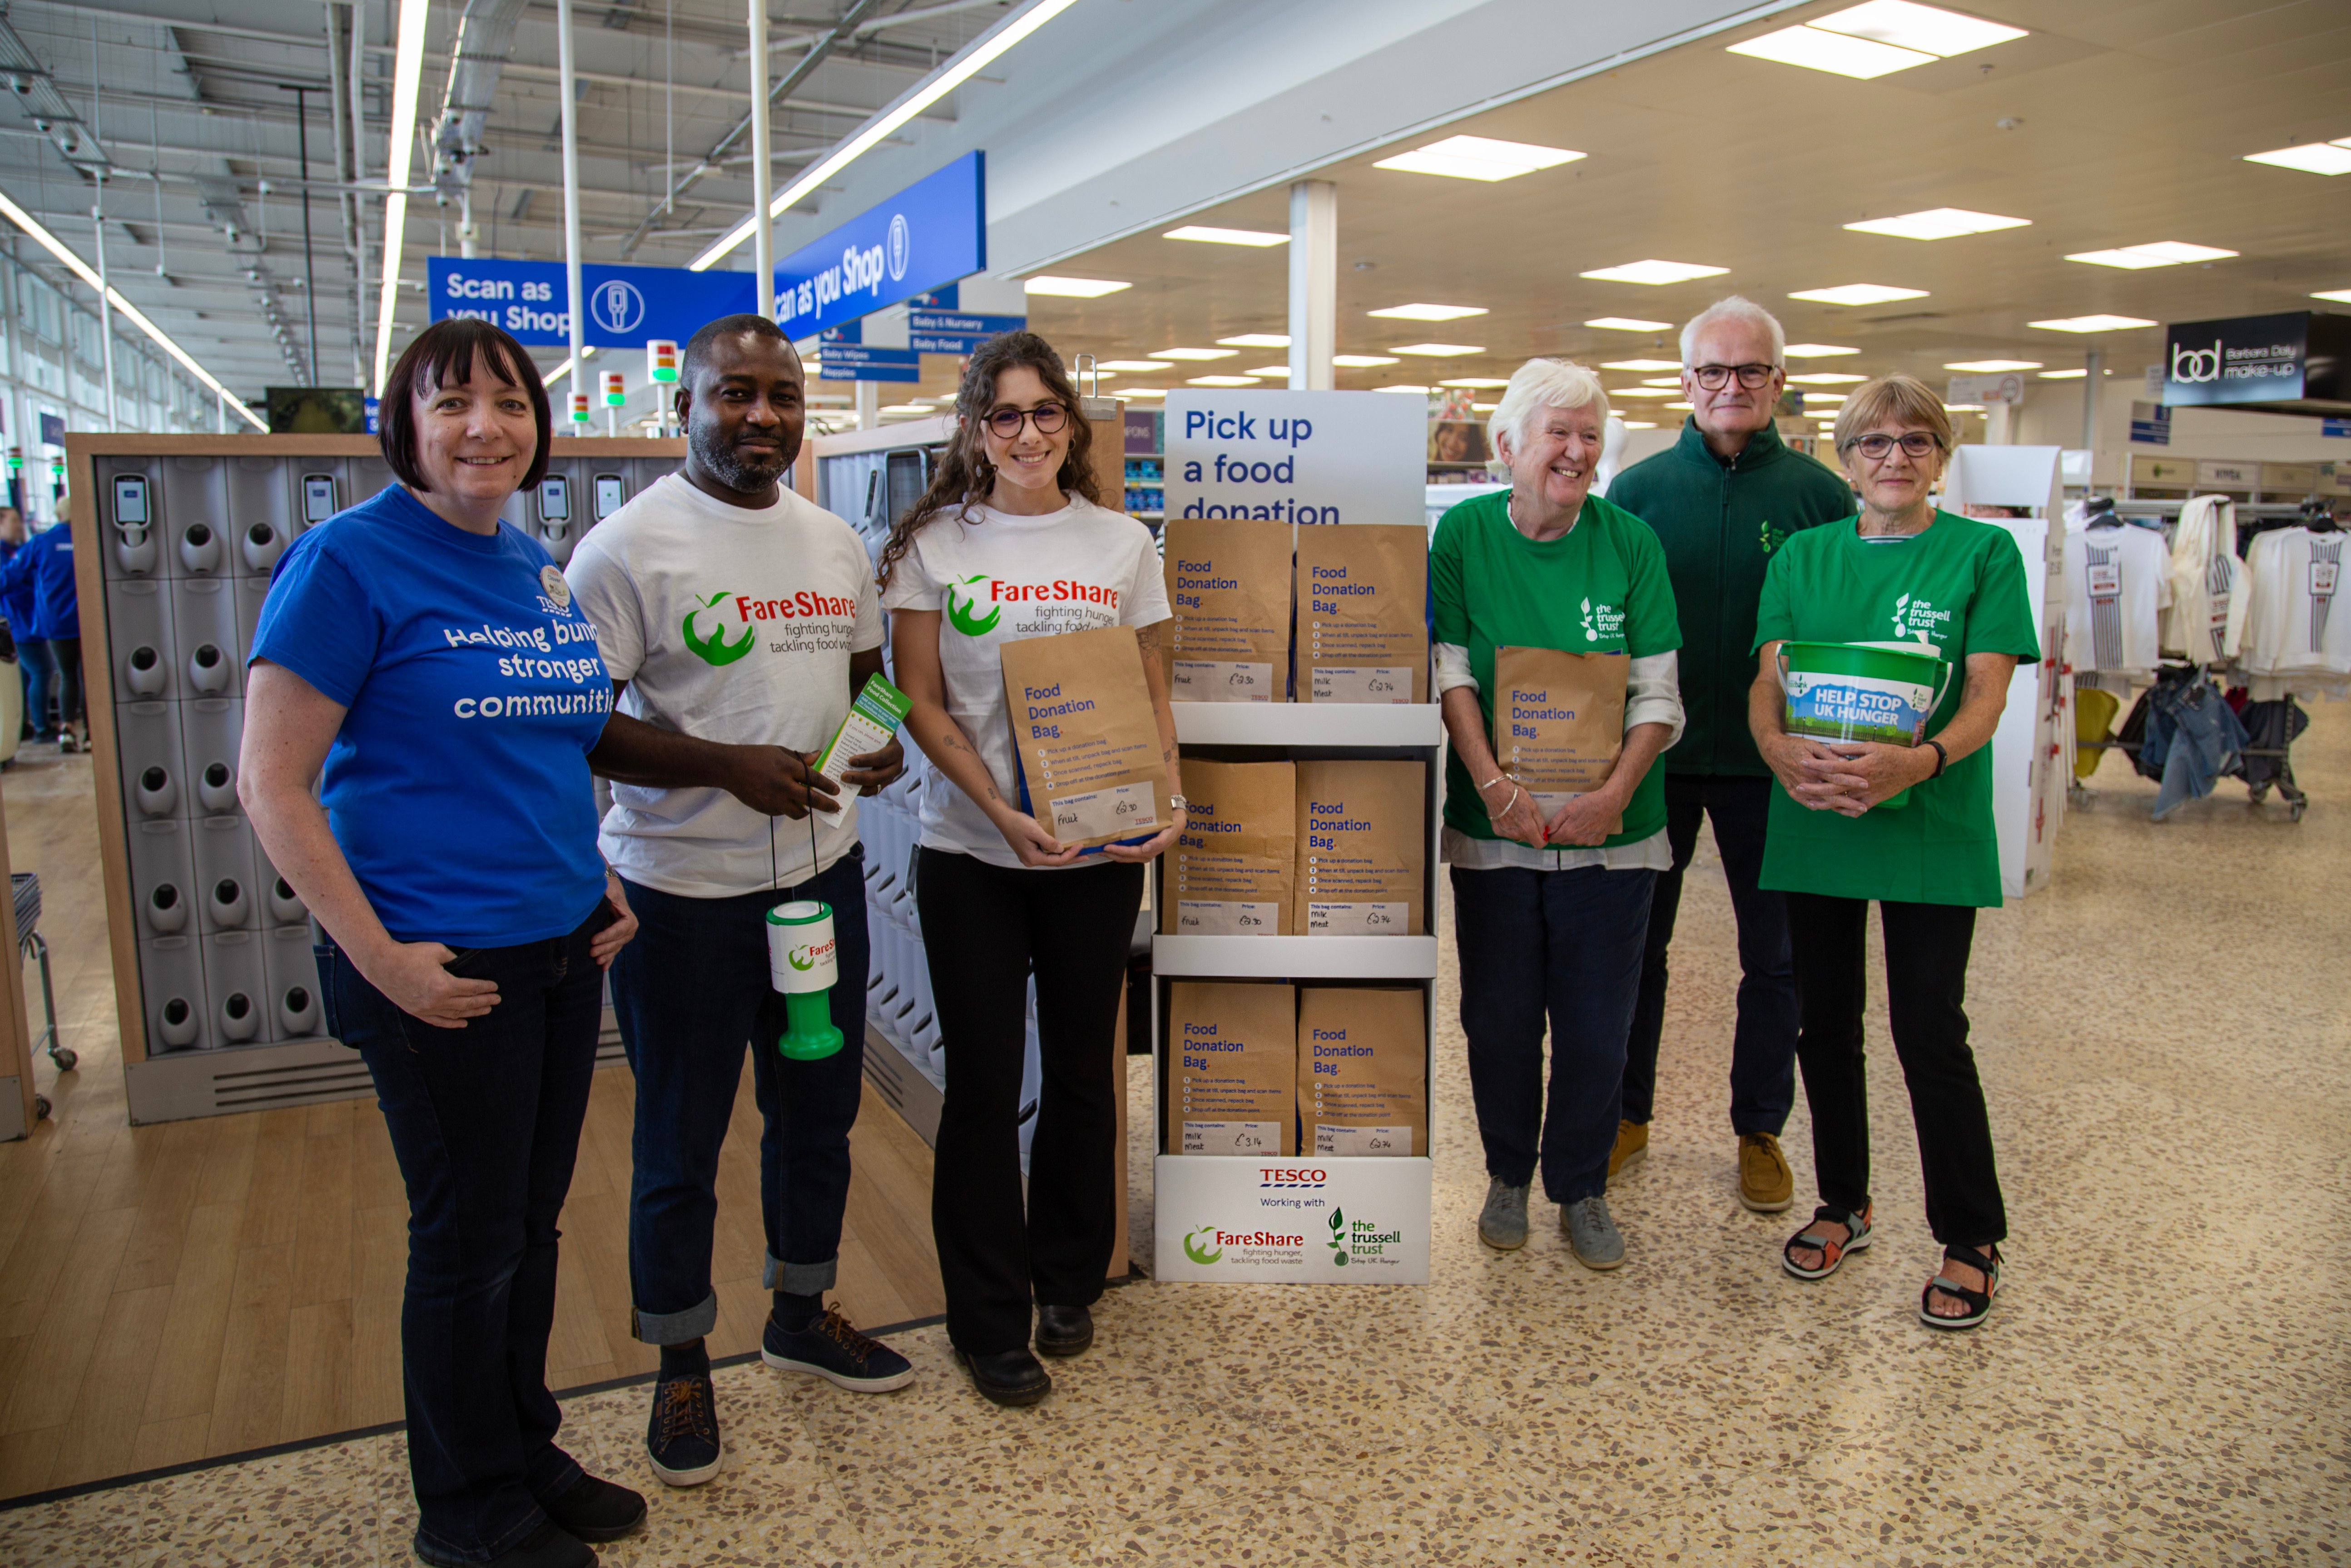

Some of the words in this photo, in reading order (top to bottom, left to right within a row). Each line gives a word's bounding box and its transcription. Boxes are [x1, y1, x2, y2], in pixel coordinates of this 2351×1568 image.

[446, 272, 515, 300] Scan
[521, 281, 552, 302] as
[774, 287, 796, 326] can
[797, 279, 813, 316] as
[813, 265, 840, 320] you
[843, 244, 884, 297] Shop
[506, 305, 570, 337] Shop
[913, 316, 937, 328] Baby
[945, 317, 982, 330] Nursery
[913, 338, 937, 350] Baby
[938, 339, 962, 350] Food
[822, 349, 842, 360] Baby
[843, 350, 869, 361] Wipes
[2271, 345, 2296, 358] Daly
[823, 367, 856, 378] Nappies
[2224, 363, 2295, 379] make-up
[1186, 410, 1256, 440] Pick
[1270, 418, 1312, 448] up
[1184, 460, 1202, 482] a
[1215, 454, 1294, 483] food
[1183, 497, 1339, 524] donation
[1177, 560, 1211, 572] Food
[1312, 566, 1347, 578] Food
[1177, 577, 1237, 589] Donation
[1312, 583, 1375, 595] Donation
[991, 580, 1118, 609] FareShare
[1176, 594, 1203, 608] Bag.
[735, 591, 855, 623] FareShare
[1312, 600, 1340, 615] Bag.
[1596, 604, 1611, 613] the
[1912, 599, 1931, 609] the
[1035, 605, 1082, 620] fighting
[1597, 611, 1625, 622] trussel
[1910, 608, 1951, 622] trussell
[784, 623, 830, 638] fighting
[831, 621, 854, 637] hunge
[1016, 620, 1062, 634] tackling
[1597, 622, 1619, 631] trust
[1909, 617, 1935, 628] trust
[444, 624, 551, 653] Helping
[769, 639, 814, 653] tackling
[816, 637, 838, 650] food
[499, 653, 600, 684] stronger
[871, 680, 893, 699] FareShare
[1025, 683, 1061, 701] Food
[1512, 690, 1547, 703] Food
[455, 687, 614, 719] communiti
[867, 686, 880, 697] Food
[879, 695, 902, 714] Collection
[1815, 688, 1856, 705] HELP
[1859, 693, 1902, 711] STOP
[1028, 700, 1095, 720] Donation
[1512, 707, 1575, 720] Donation
[1815, 703, 1835, 717] UK
[1837, 706, 1899, 725] HUNGER
[1032, 725, 1063, 739] Bag.
[1512, 724, 1540, 739] Bag.
[1072, 742, 1095, 750] donation
[1075, 794, 1097, 802] contains:
[1116, 801, 1137, 815] £2.30
[1185, 801, 1214, 815] ood
[1310, 802, 1343, 814] Food
[1058, 813, 1078, 826] Fruit
[1310, 819, 1371, 831] Donation
[1179, 835, 1207, 849] Bag.
[1309, 836, 1337, 851] Bag.
[809, 938, 835, 956] FareS
[1184, 1023, 1217, 1035] Food
[1313, 1029, 1346, 1041] Food
[1184, 1039, 1244, 1052] Donation
[1313, 1045, 1374, 1057] Donation
[1183, 1056, 1210, 1071] Bag.
[1314, 1062, 1341, 1076] Bag.
[1260, 1169, 1327, 1182] TESCO
[1260, 1198, 1301, 1209] Working
[1304, 1198, 1325, 1207] with
[1352, 1220, 1375, 1232] the
[1216, 1231, 1304, 1246] FareShare
[1351, 1231, 1401, 1243] trussell
[1243, 1249, 1272, 1257] fighting
[1351, 1244, 1383, 1254] trust
[1231, 1257, 1260, 1266] tackling
[1351, 1257, 1366, 1266] Stop
[1380, 1257, 1400, 1266] Hunger
